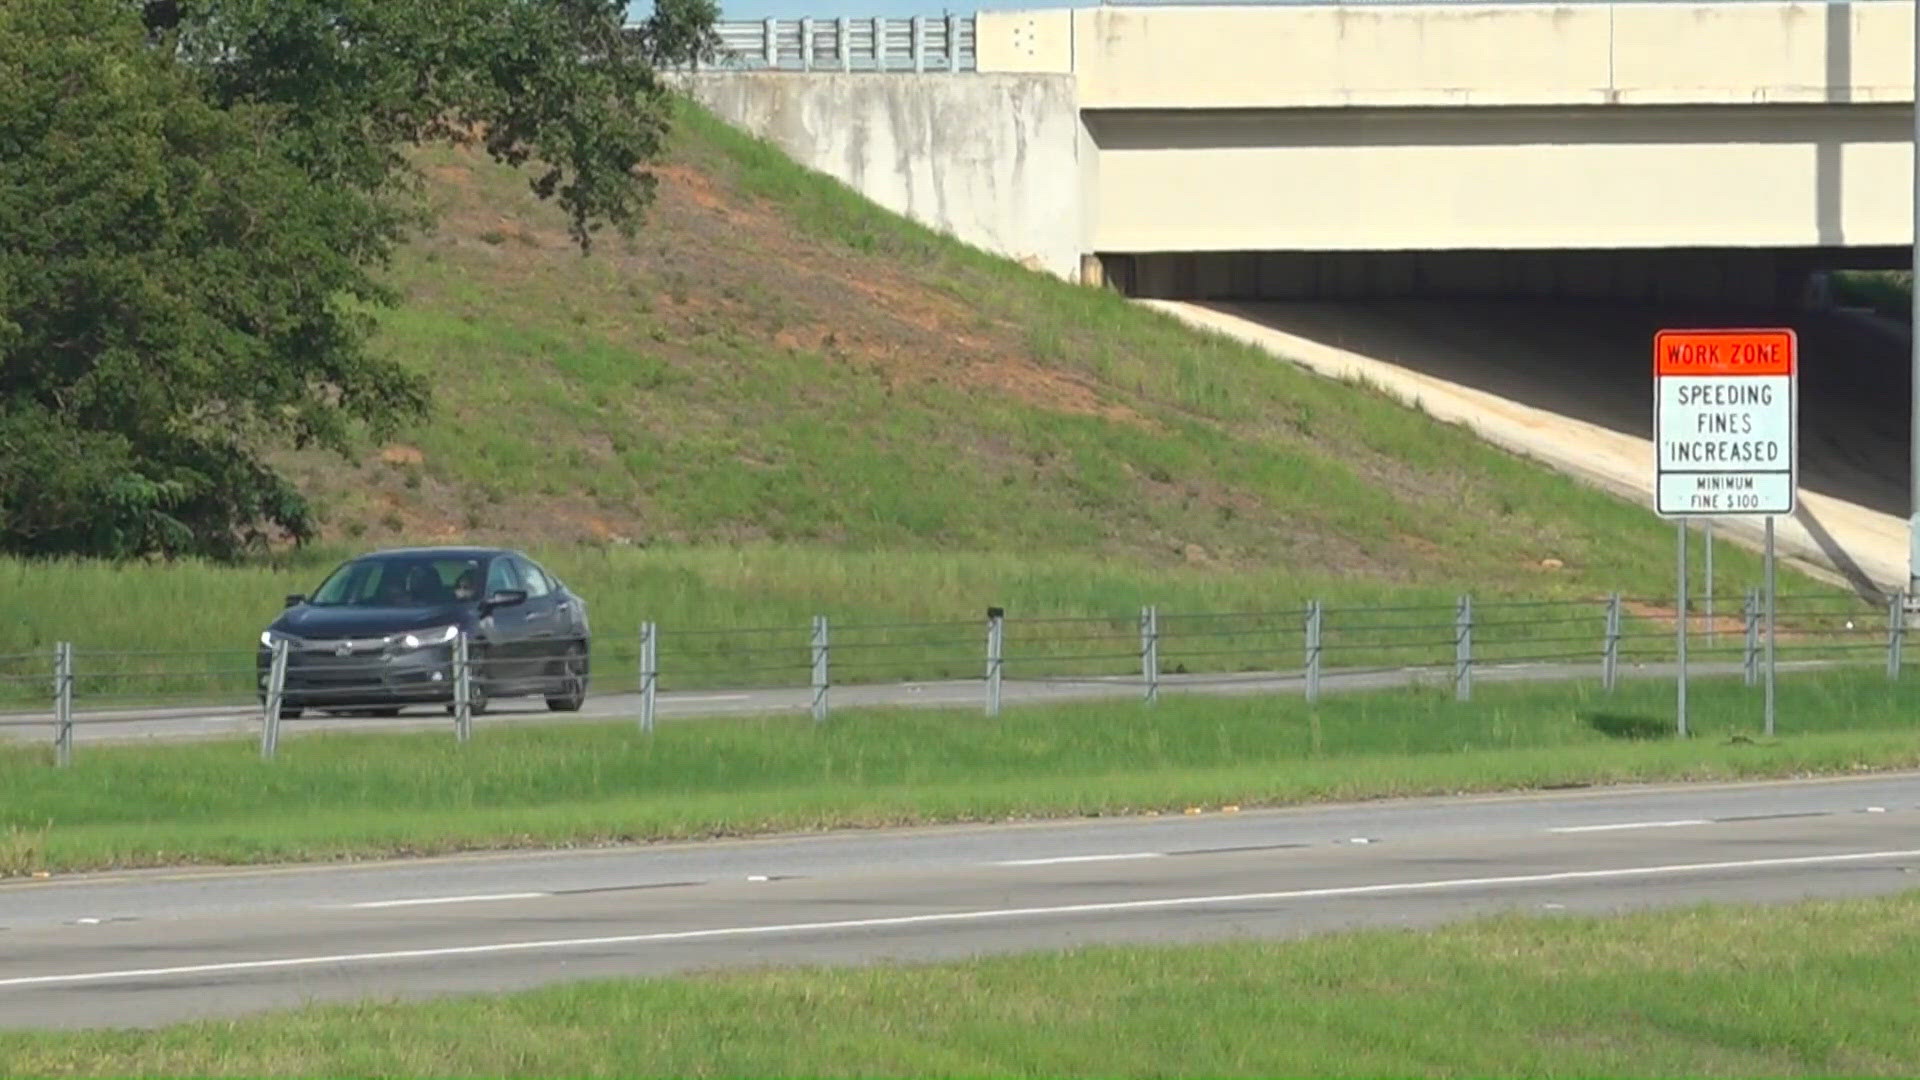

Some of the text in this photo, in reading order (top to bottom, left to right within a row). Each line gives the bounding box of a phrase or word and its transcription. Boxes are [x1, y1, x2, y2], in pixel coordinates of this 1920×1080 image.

[1667, 343, 1781, 365] WORK ZONE
[1678, 384, 1773, 406] SPEEDING
[1697, 413, 1752, 434] FINES
[1671, 441, 1778, 462] INCREASED
[1696, 477, 1754, 490] MINIMUM
[1691, 494, 1759, 508] FINE $100
